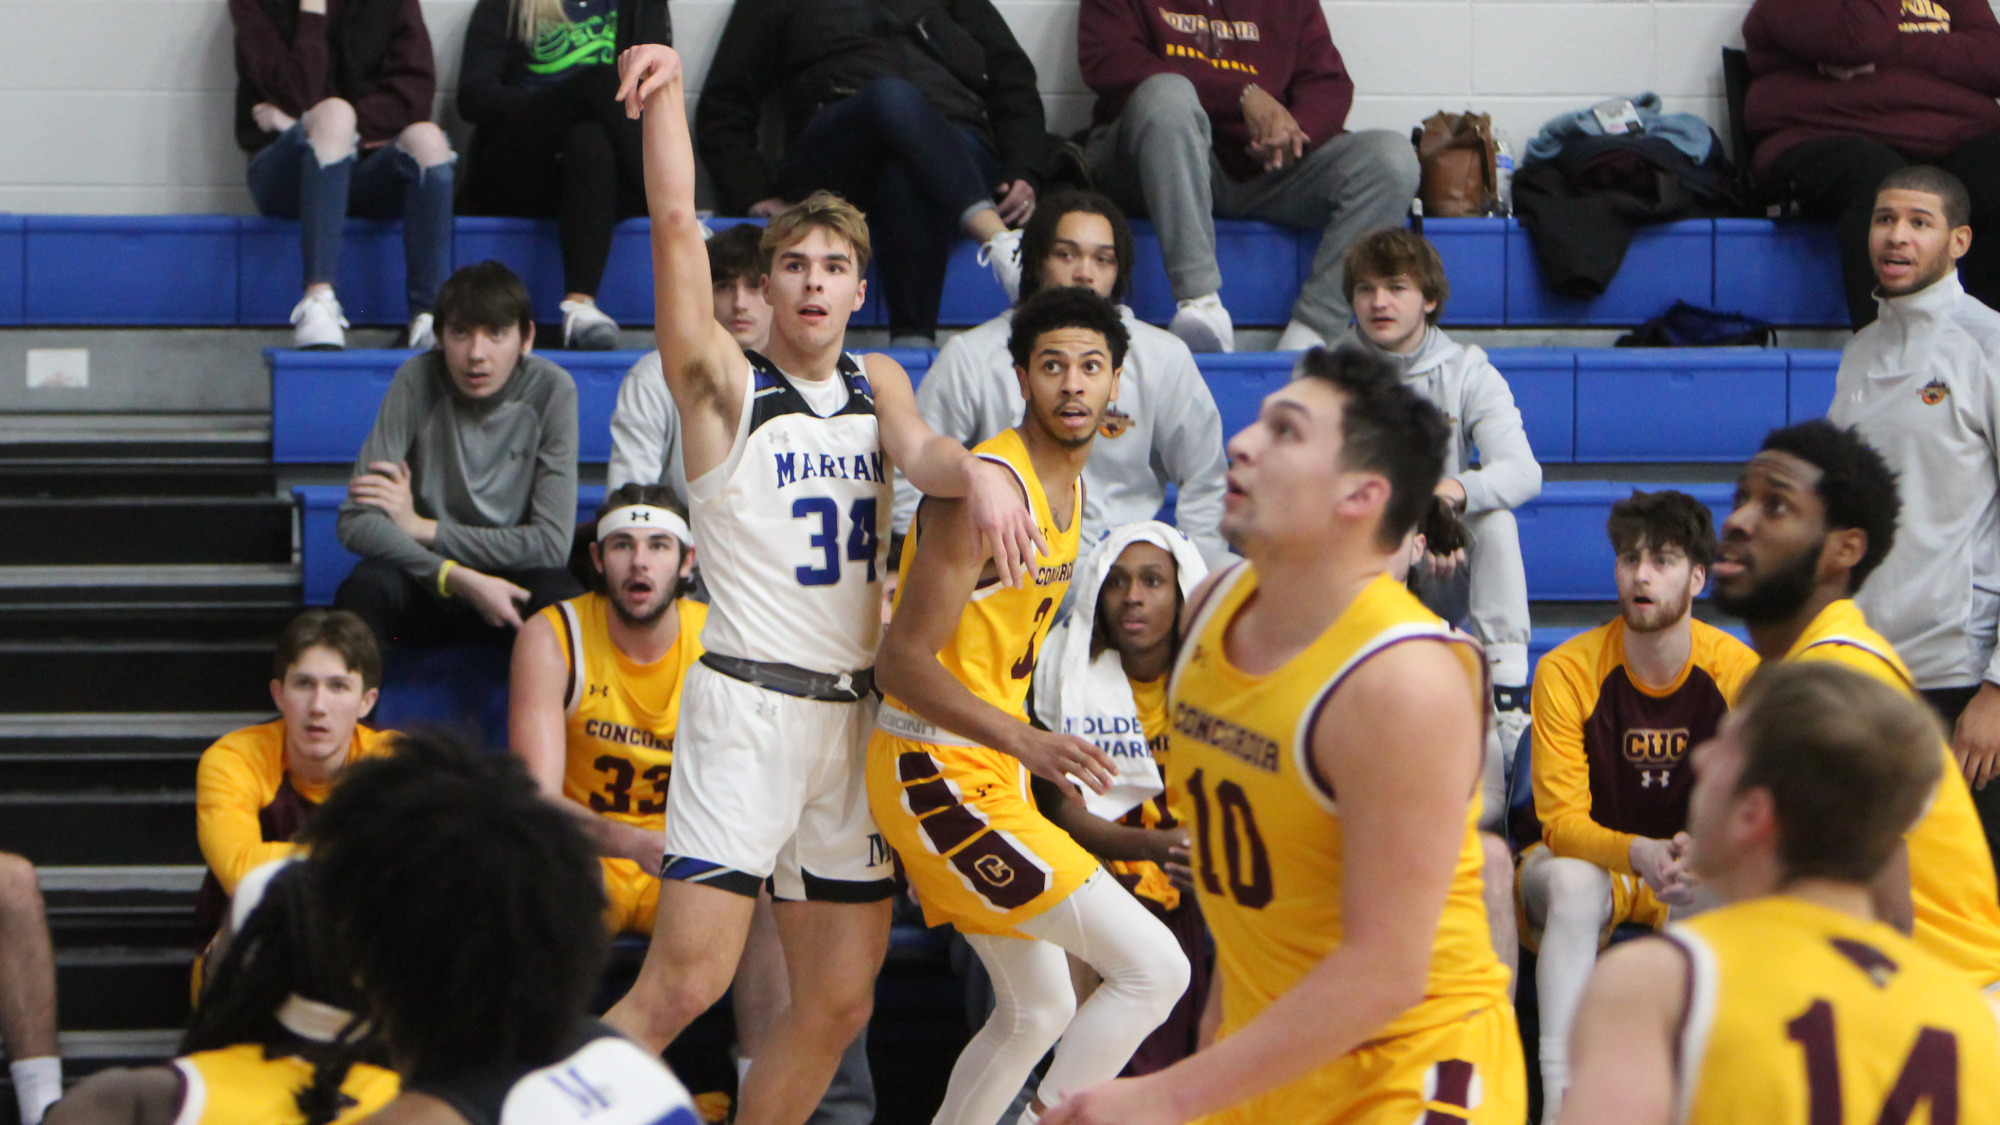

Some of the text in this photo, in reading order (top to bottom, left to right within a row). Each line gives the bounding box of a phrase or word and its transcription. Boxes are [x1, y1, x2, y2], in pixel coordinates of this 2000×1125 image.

[774, 452, 886, 489] MARIAN
[791, 496, 881, 586] 34
[1010, 596, 1053, 680] 3
[1624, 728, 1690, 763] CUC
[589, 754, 672, 815] 33
[865, 832, 893, 868] M
[1186, 767, 1275, 910] 10
